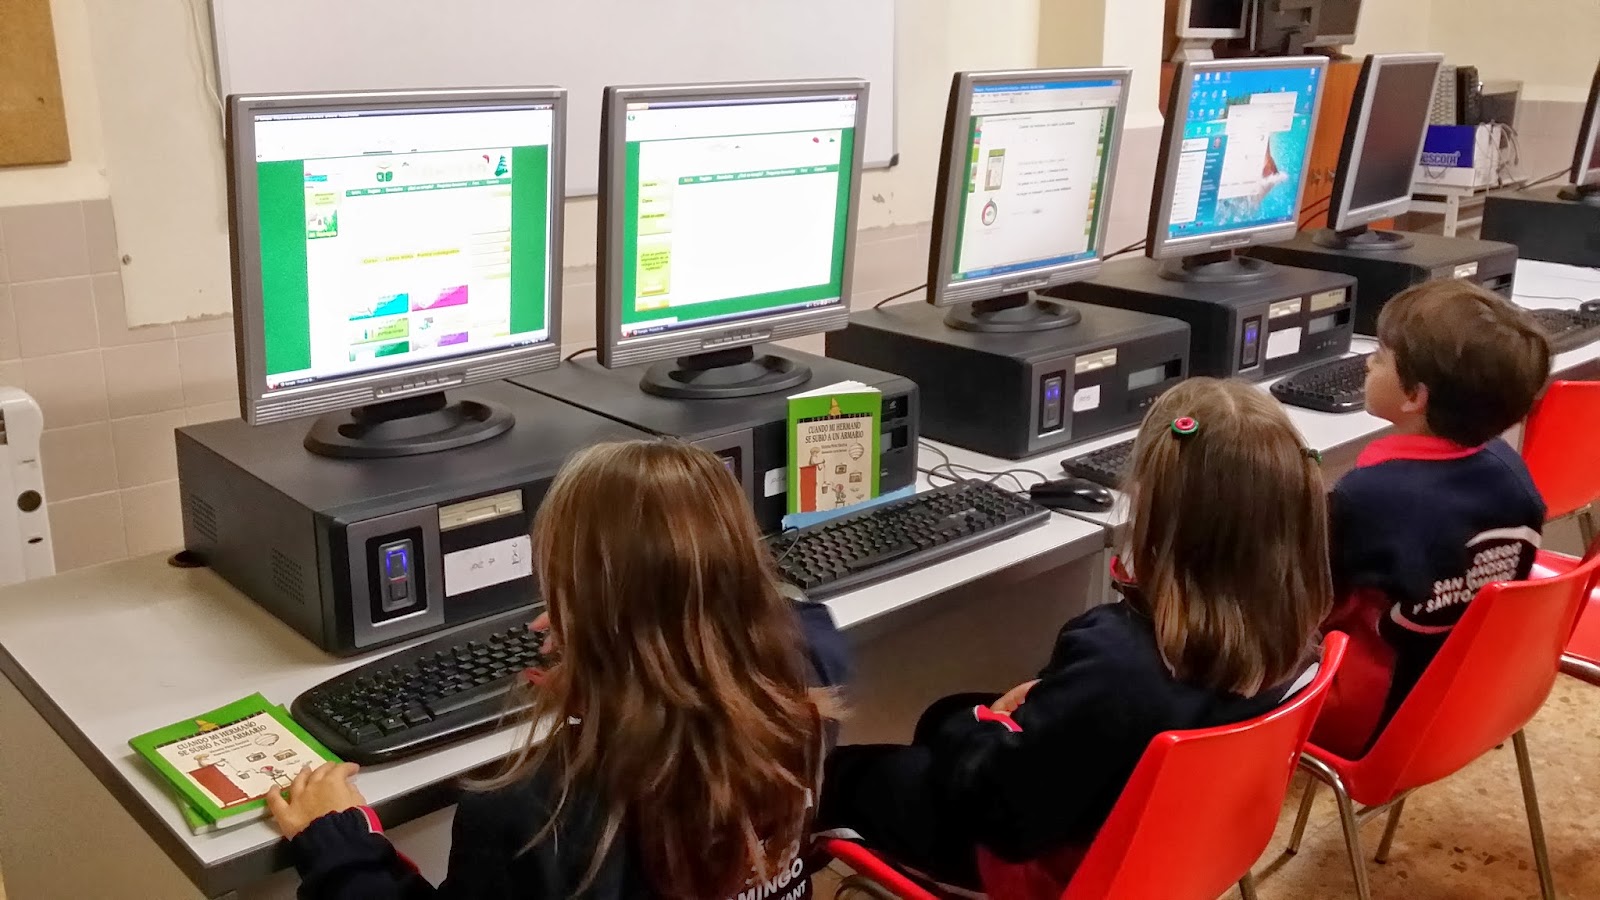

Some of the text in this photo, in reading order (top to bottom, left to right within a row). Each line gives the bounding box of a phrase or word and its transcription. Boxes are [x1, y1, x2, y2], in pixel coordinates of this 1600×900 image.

[805, 435, 812, 443] SE
[827, 433, 832, 441] A
[832, 432, 840, 440] UN
[841, 430, 864, 440] ARMARIO
[808, 421, 861, 434] CUANDO MI HERMANO
[1426, 588, 1475, 613] SANTO
[176, 737, 209, 750] CUANDO
[219, 721, 257, 738] HERMANO
[177, 749, 190, 757] SE
[219, 737, 233, 745] UN
[233, 724, 267, 741] ARMARIO
[727, 858, 803, 900] MINGO
